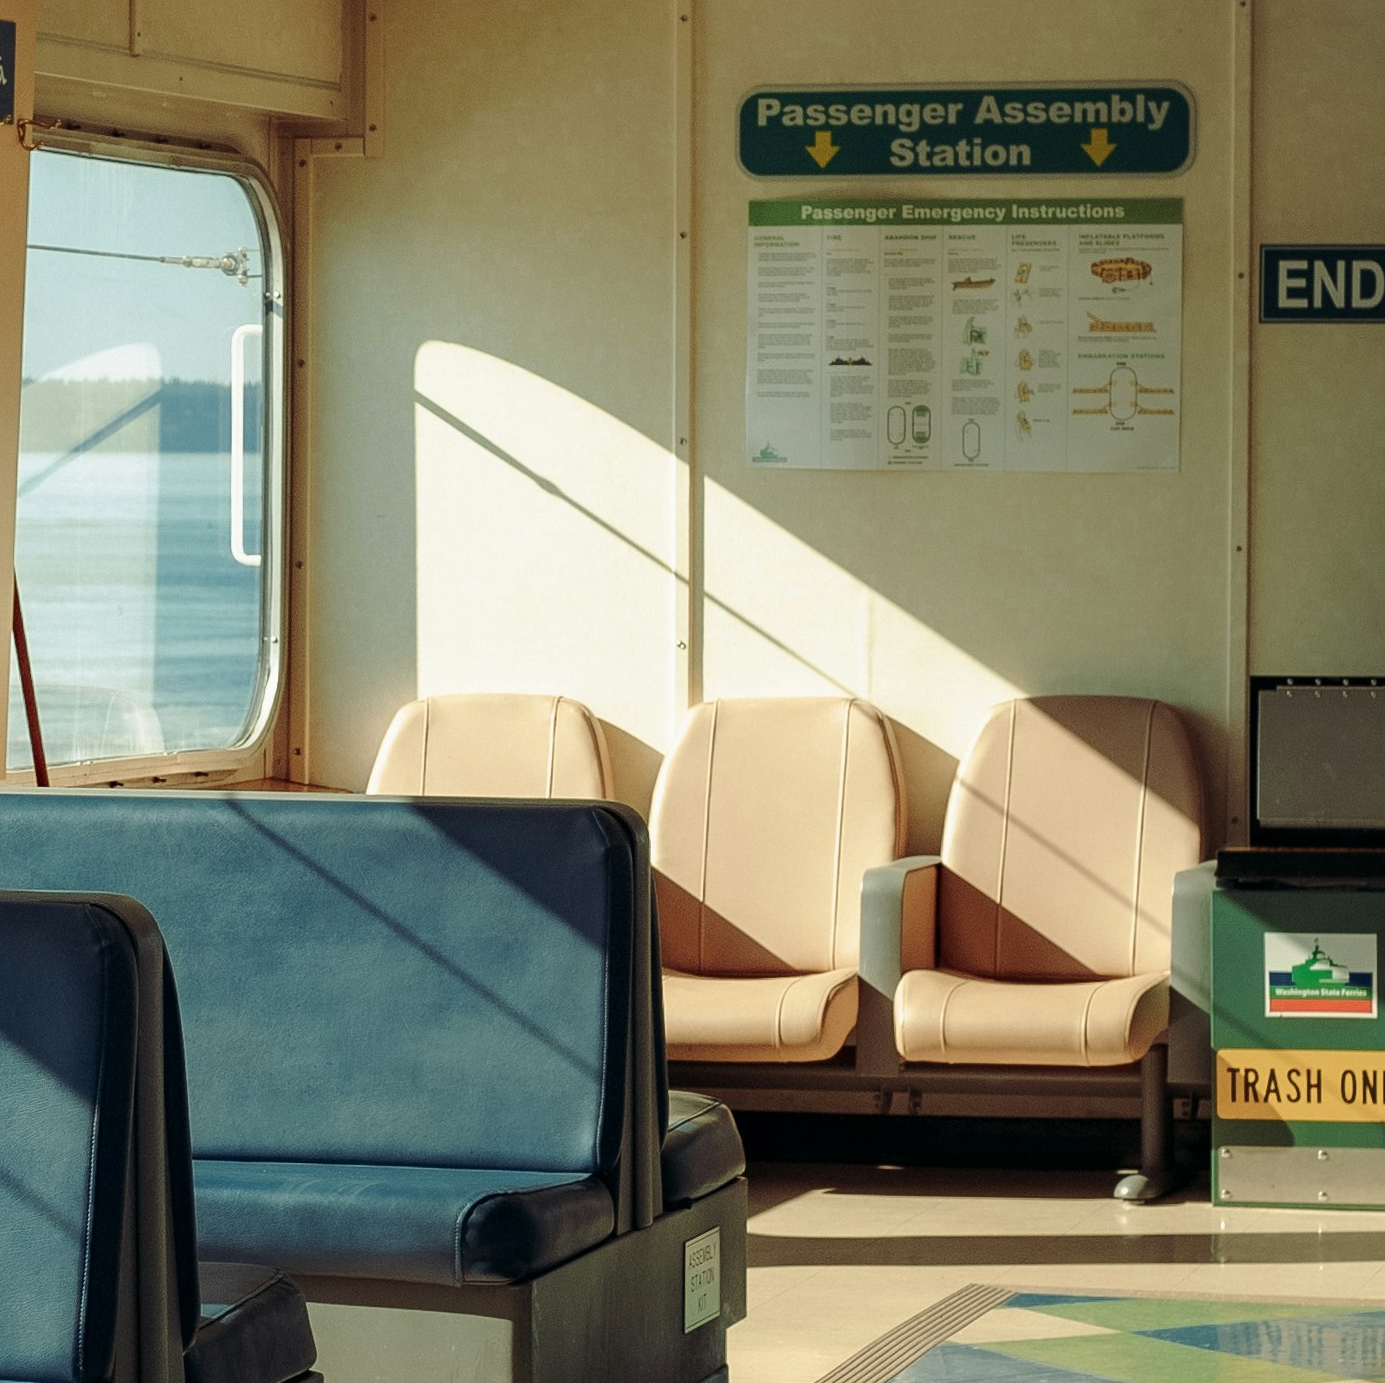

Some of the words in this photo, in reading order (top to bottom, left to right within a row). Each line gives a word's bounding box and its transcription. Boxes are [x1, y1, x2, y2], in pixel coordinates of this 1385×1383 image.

[757, 98, 963, 132] Passenger
[974, 94, 1170, 131] Assembly
[889, 138, 1031, 167] Station
[801, 204, 897, 222] Passenger
[901, 204, 1006, 222] Emergency
[1012, 204, 1125, 219] Instructions
[1278, 259, 1385, 309] END
[1276, 988, 1320, 998] Washington
[1321, 988, 1340, 997] State
[1341, 988, 1367, 997] Ferries
[1227, 1068, 1322, 1104] TRASH
[1341, 1069, 1385, 1105] ON
[688, 1241, 718, 1269] ASSEMBLY
[691, 1267, 715, 1293] STATION
[697, 1293, 707, 1313] KIT
